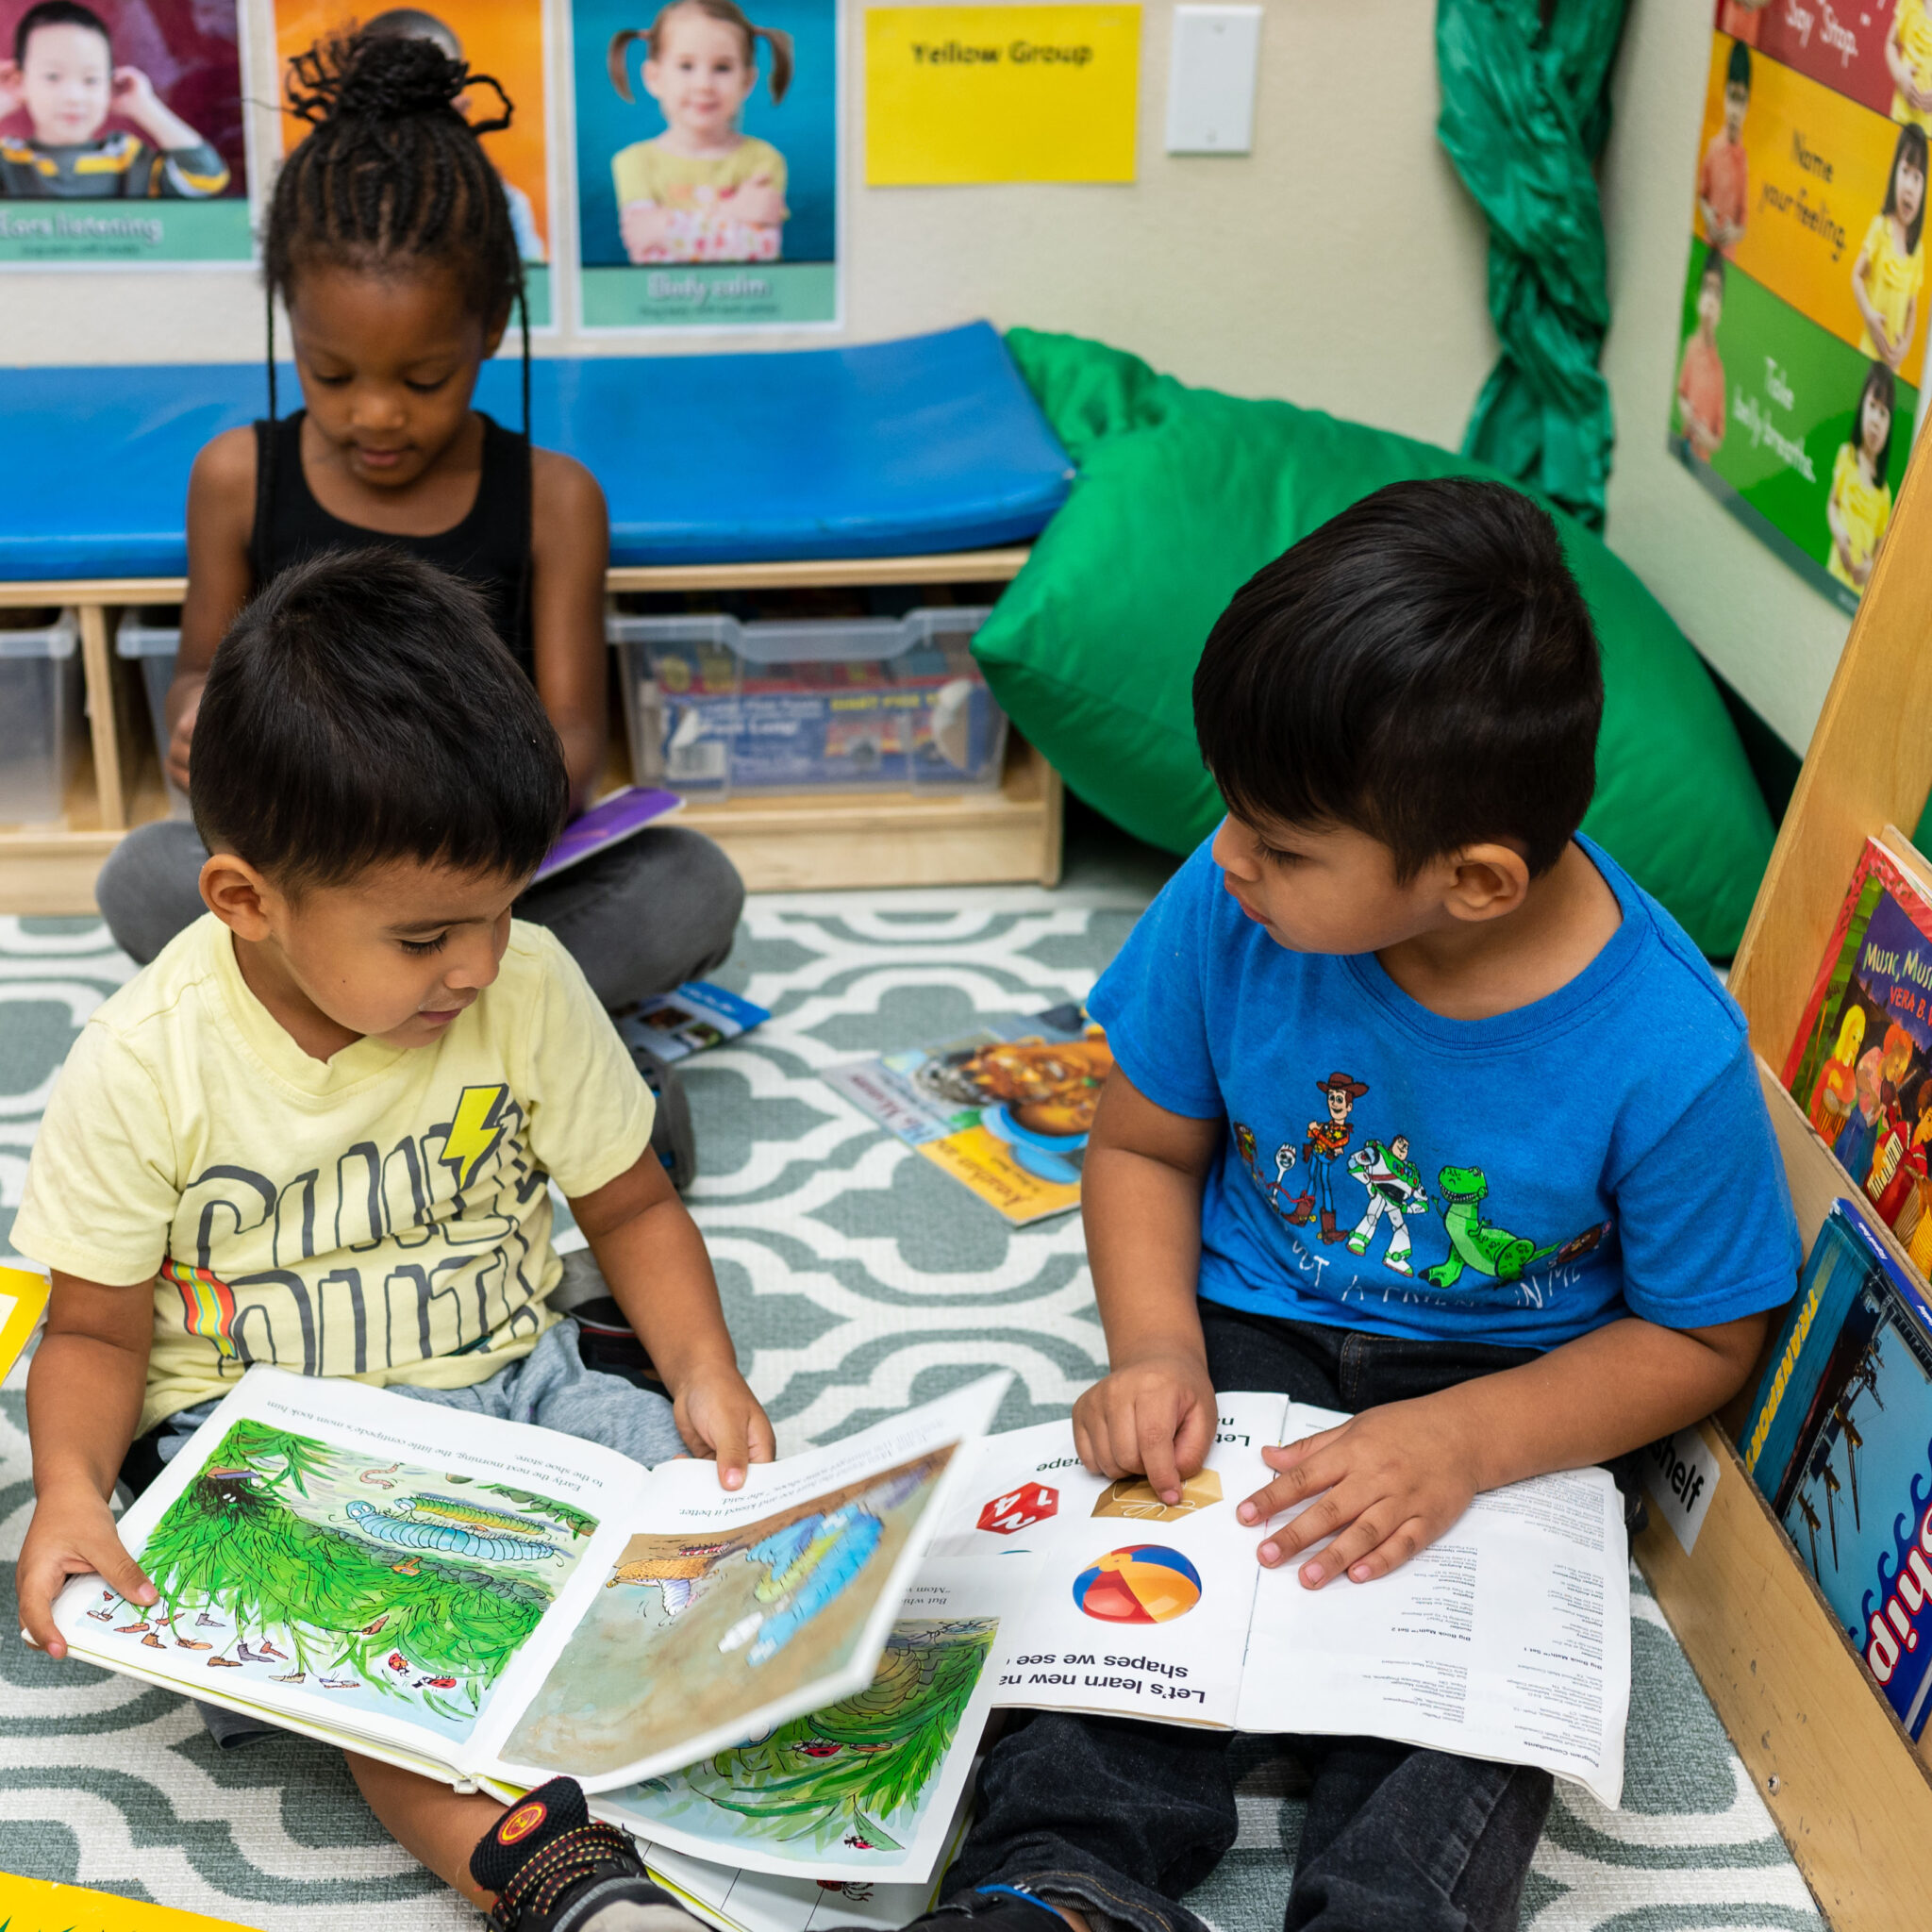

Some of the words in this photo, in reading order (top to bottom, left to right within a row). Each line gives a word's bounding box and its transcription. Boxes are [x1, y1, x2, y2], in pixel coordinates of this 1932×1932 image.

[909, 41, 1001, 66] Yellow
[1008, 41, 1093, 72] Group
[1792, 126, 1833, 183] Name
[1890, 985, 1915, 1012] VERA
[1915, 997, 1926, 1020] B.
[267, 1401, 288, 1412] him
[291, 1409, 313, 1420] took
[317, 1416, 343, 1426] mom
[347, 1424, 406, 1444] centipede's
[408, 1442, 432, 1453] little
[455, 1453, 504, 1468] morning,
[516, 1456, 541, 1465] store.
[507, 1465, 529, 1474] next
[545, 1463, 570, 1474] shoe
[573, 1473, 590, 1481] the
[555, 1478, 581, 1491] Early
[592, 1479, 603, 1488] to
[1016, 1655, 1057, 1665] see
[1063, 1655, 1095, 1664] we
[1571, 1657, 1588, 1666] Book
[1104, 1656, 1188, 1678] shapes
[1028, 1674, 1076, 1685] new
[1085, 1675, 1142, 1694] learn
[1151, 1684, 1205, 1704] Let's
[1524, 1741, 1568, 1755] Consultants
[1570, 1753, 1599, 1768] Program
